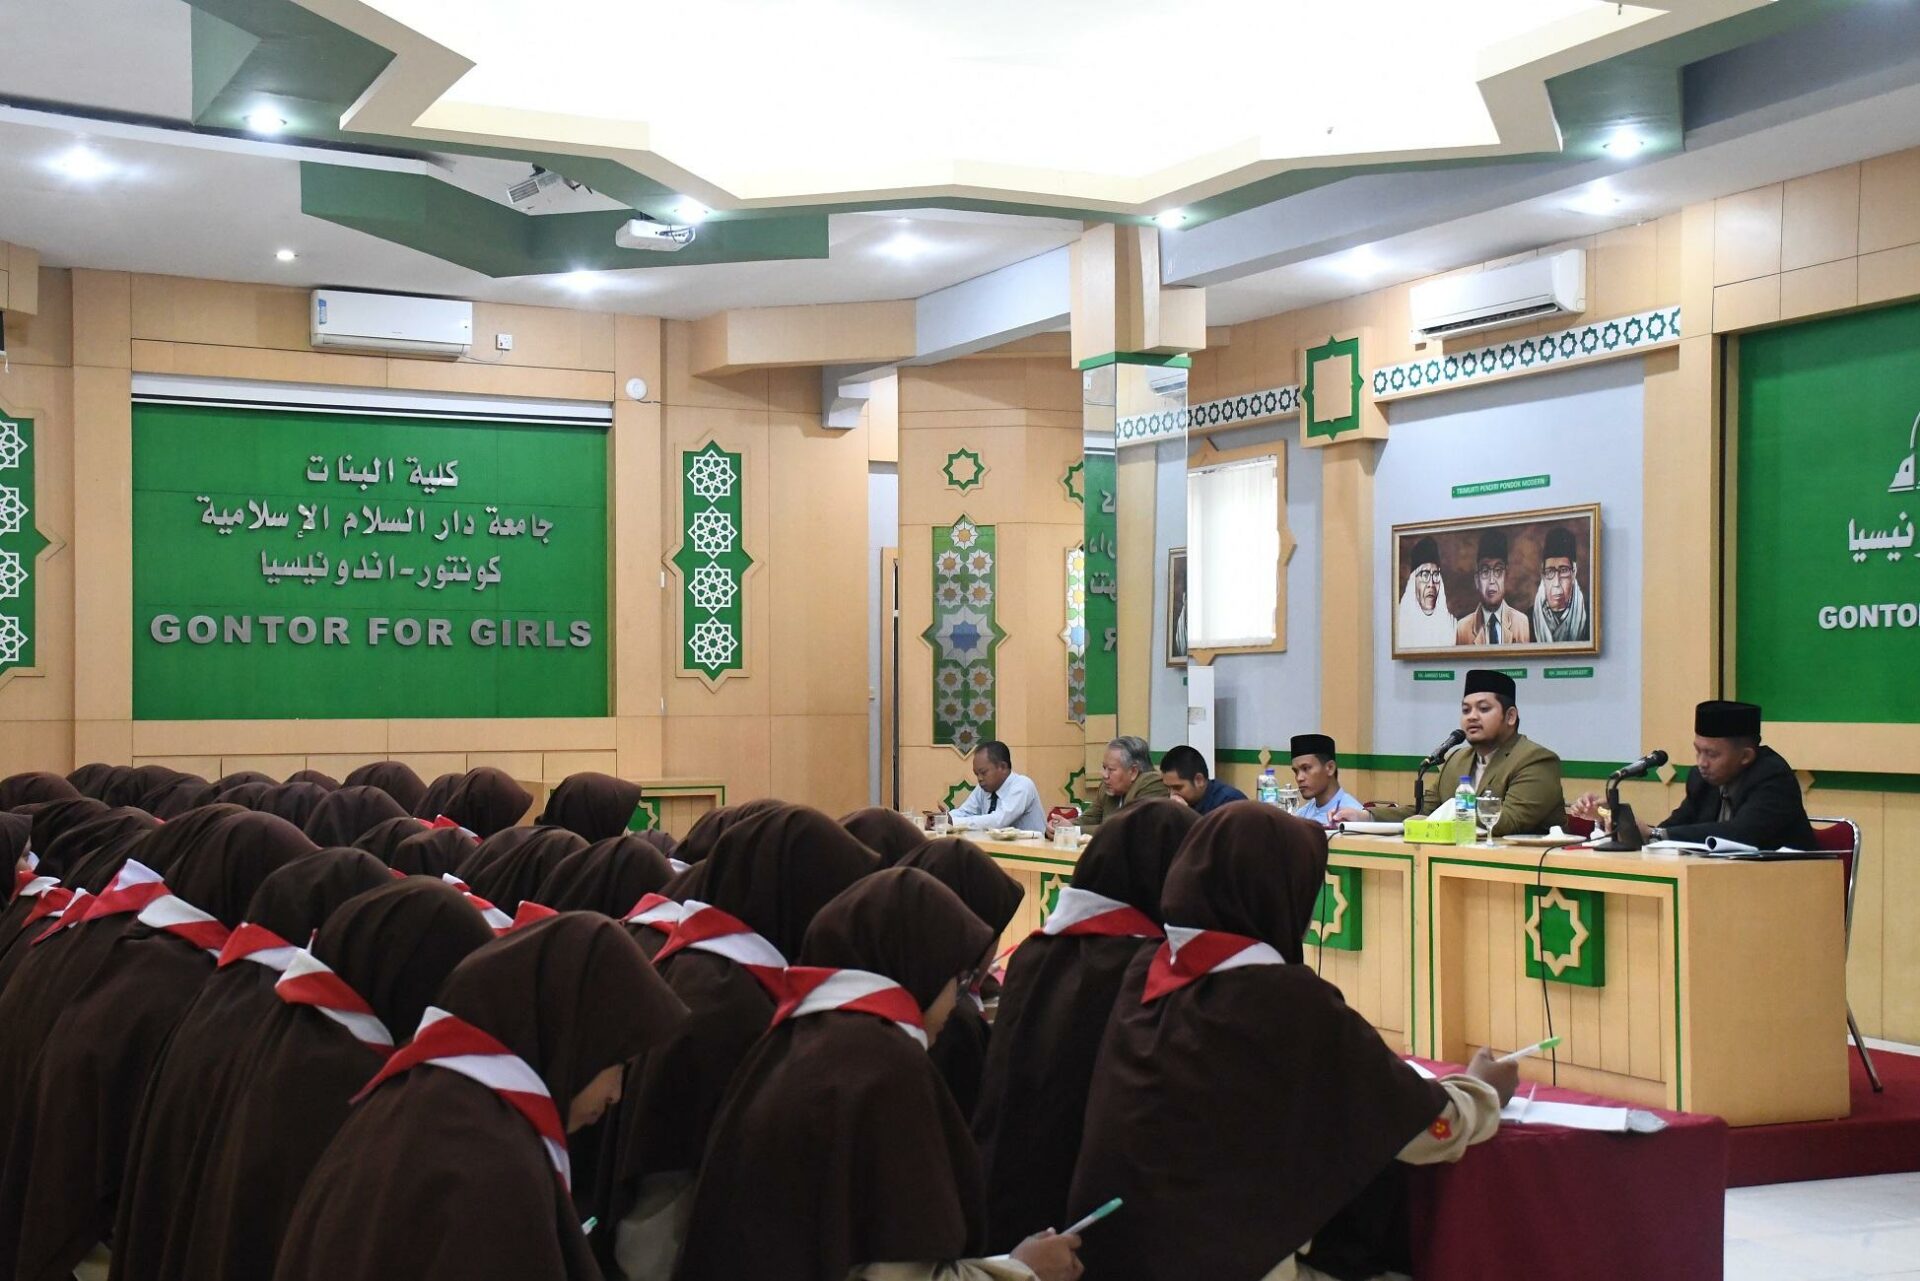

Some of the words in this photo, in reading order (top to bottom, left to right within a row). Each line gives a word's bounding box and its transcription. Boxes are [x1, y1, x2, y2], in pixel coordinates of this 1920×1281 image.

[306, 454, 394, 491] البنات
[406, 455, 458, 494] كلية
[343, 504, 425, 538] السلام
[434, 510, 475, 540] دار
[485, 506, 554, 545] جامعة
[1849, 511, 1920, 562] نيسيا
[150, 614, 350, 645] GONTOR
[368, 617, 453, 647] FOR
[470, 619, 592, 647] GIRLS
[1818, 603, 1920, 630] GONTO
